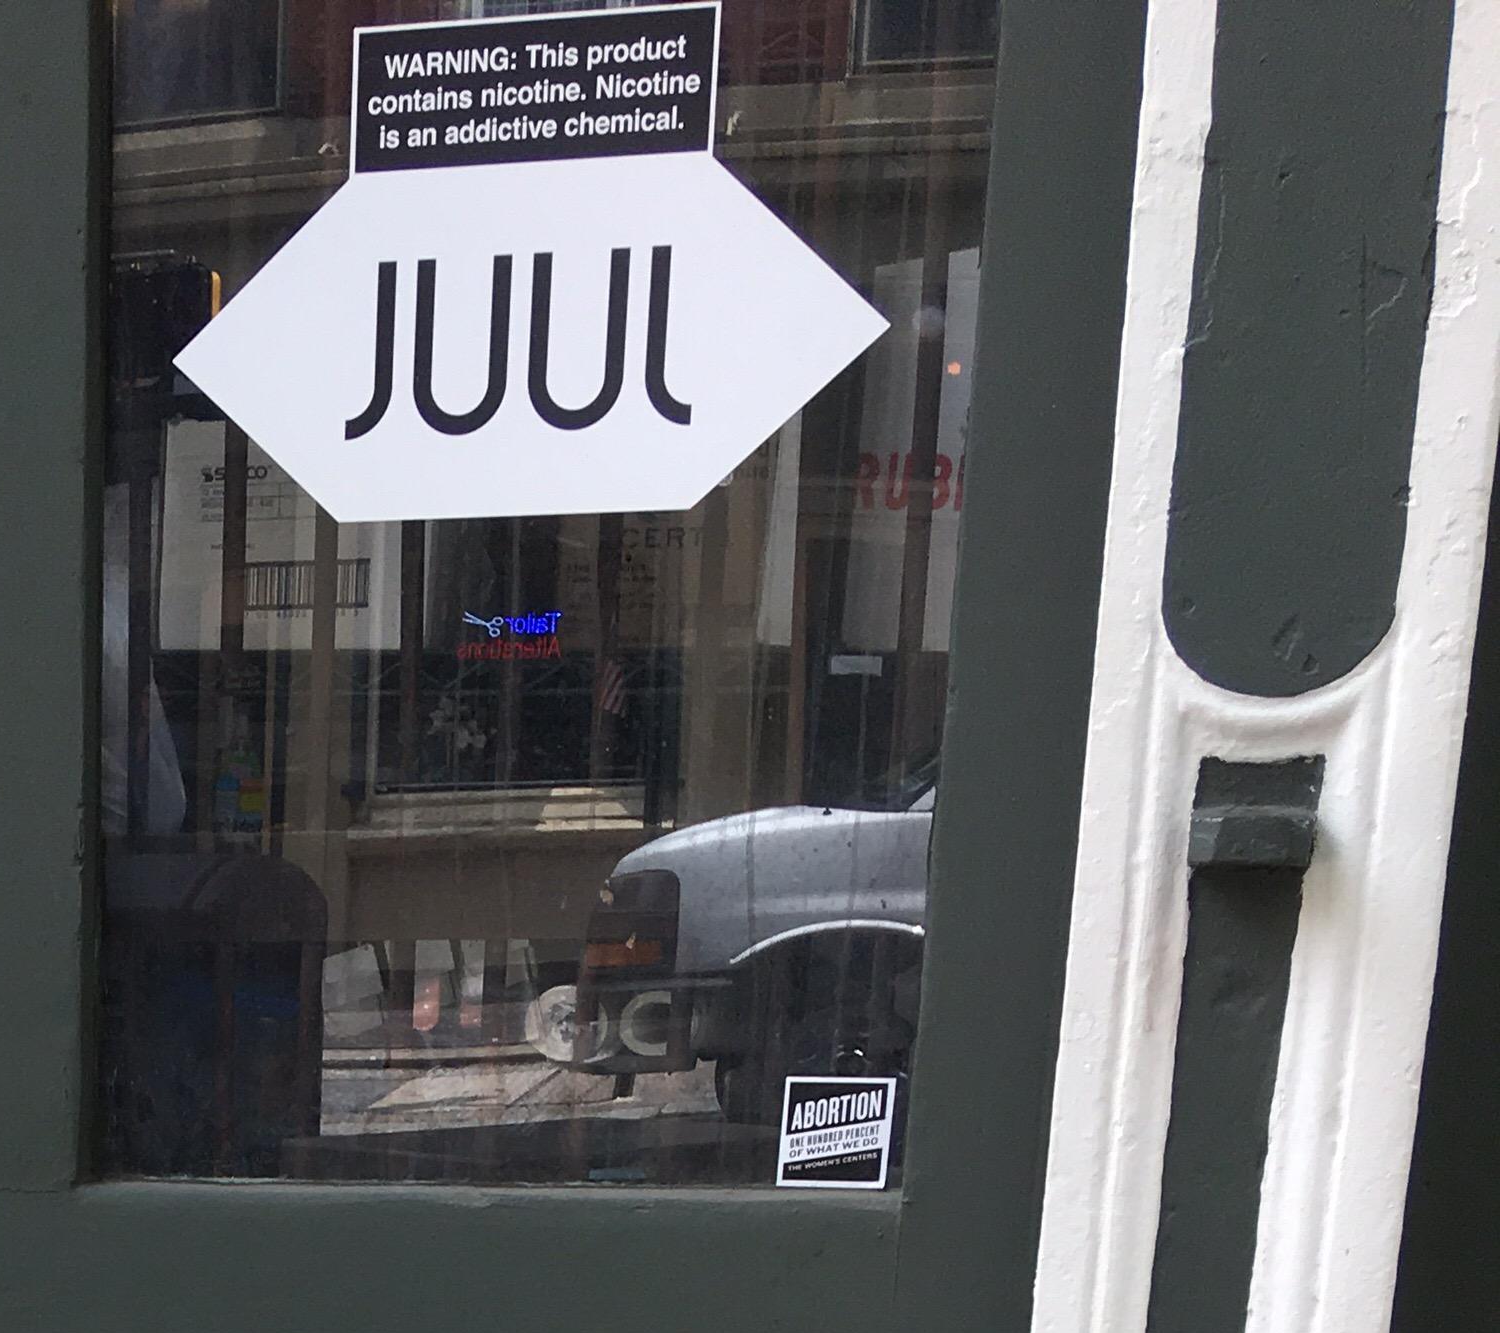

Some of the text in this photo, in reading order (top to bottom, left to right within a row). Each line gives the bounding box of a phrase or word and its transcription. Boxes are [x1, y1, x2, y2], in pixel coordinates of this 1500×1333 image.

[385, 35, 687, 79] WARNING: This product
[368, 72, 701, 116] contains nicotine. Nicotine
[379, 105, 685, 150] is an addictive chemical.
[344, 244, 693, 442] JUUL
[790, 1089, 883, 1131] ABORTION
[788, 1137, 879, 1158] OF WHAT WE DO
[789, 1124, 880, 1149] ONE HUNDRED PERCENT
[787, 1152, 878, 1172] THE WOMEN'S CENTERS
